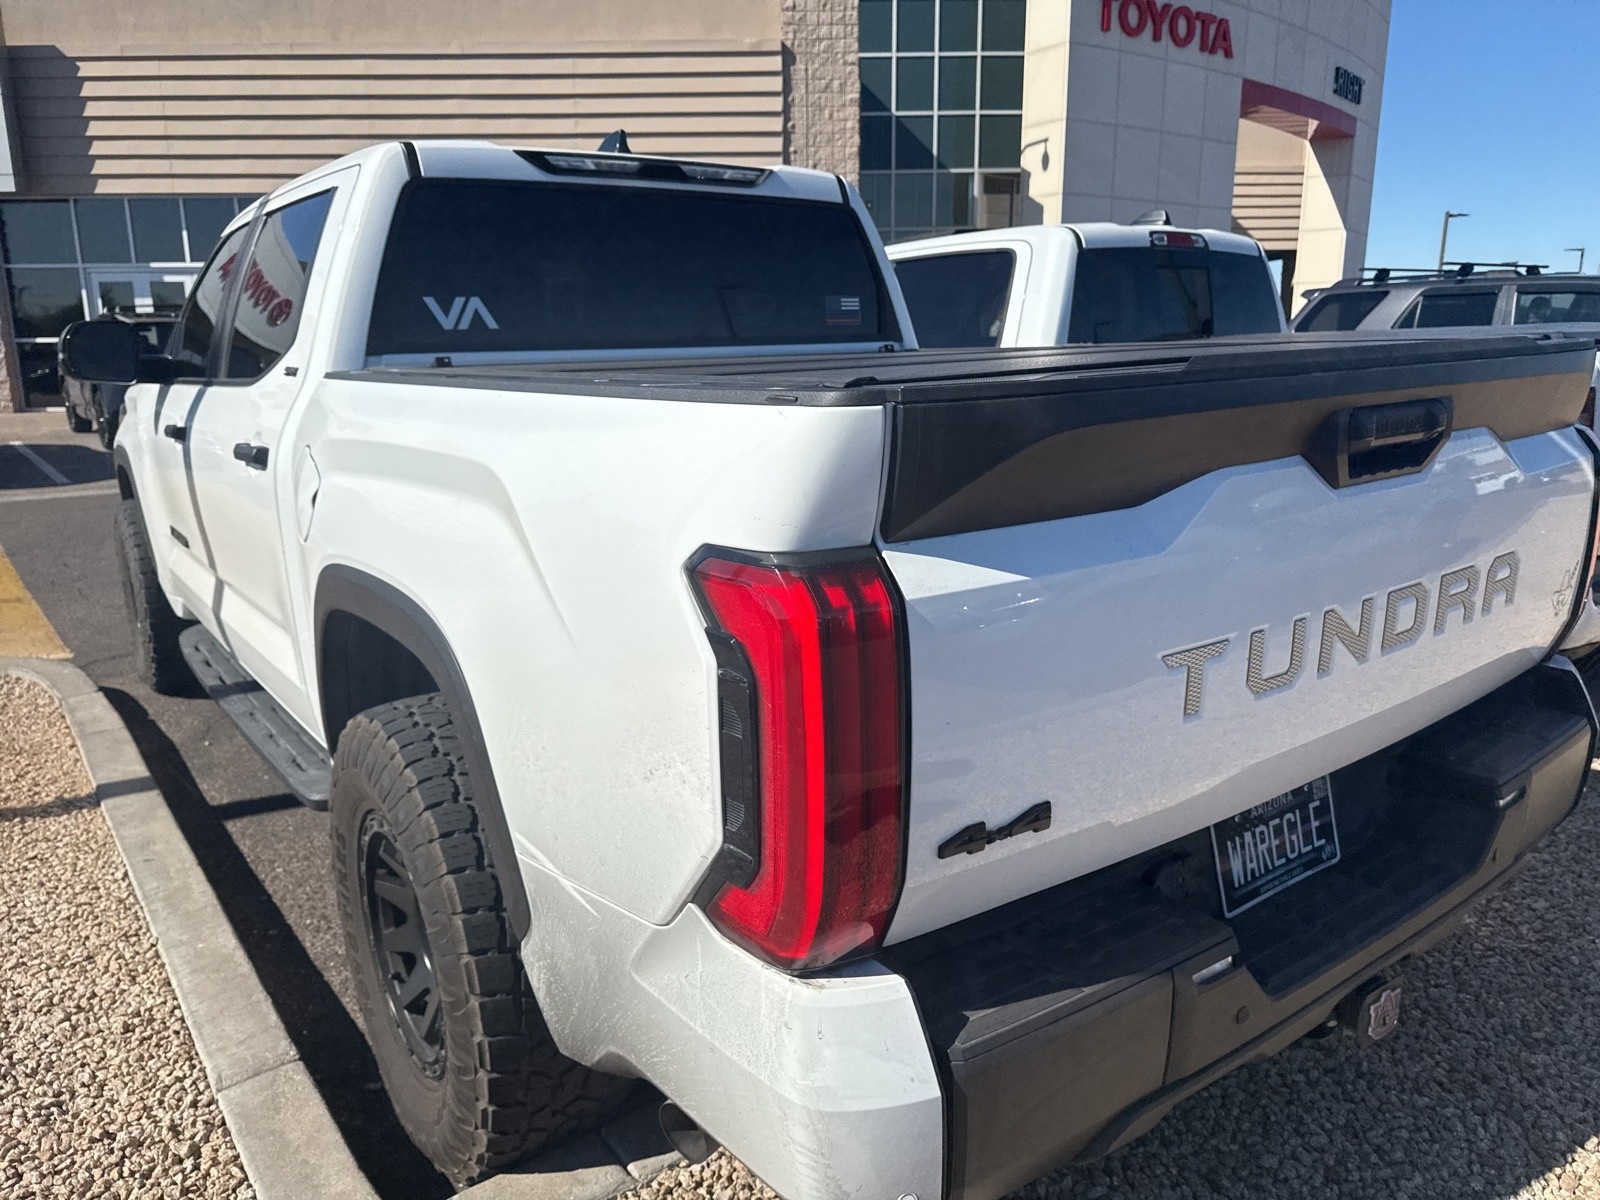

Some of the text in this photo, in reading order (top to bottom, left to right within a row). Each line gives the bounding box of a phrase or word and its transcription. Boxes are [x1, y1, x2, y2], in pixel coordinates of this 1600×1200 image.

[1098, 0, 1233, 59] TOYOTA
[1160, 550, 1520, 718] TUNDRA
[1251, 792, 1293, 817] ARIZONA
[1227, 800, 1326, 888] WAREGLE
